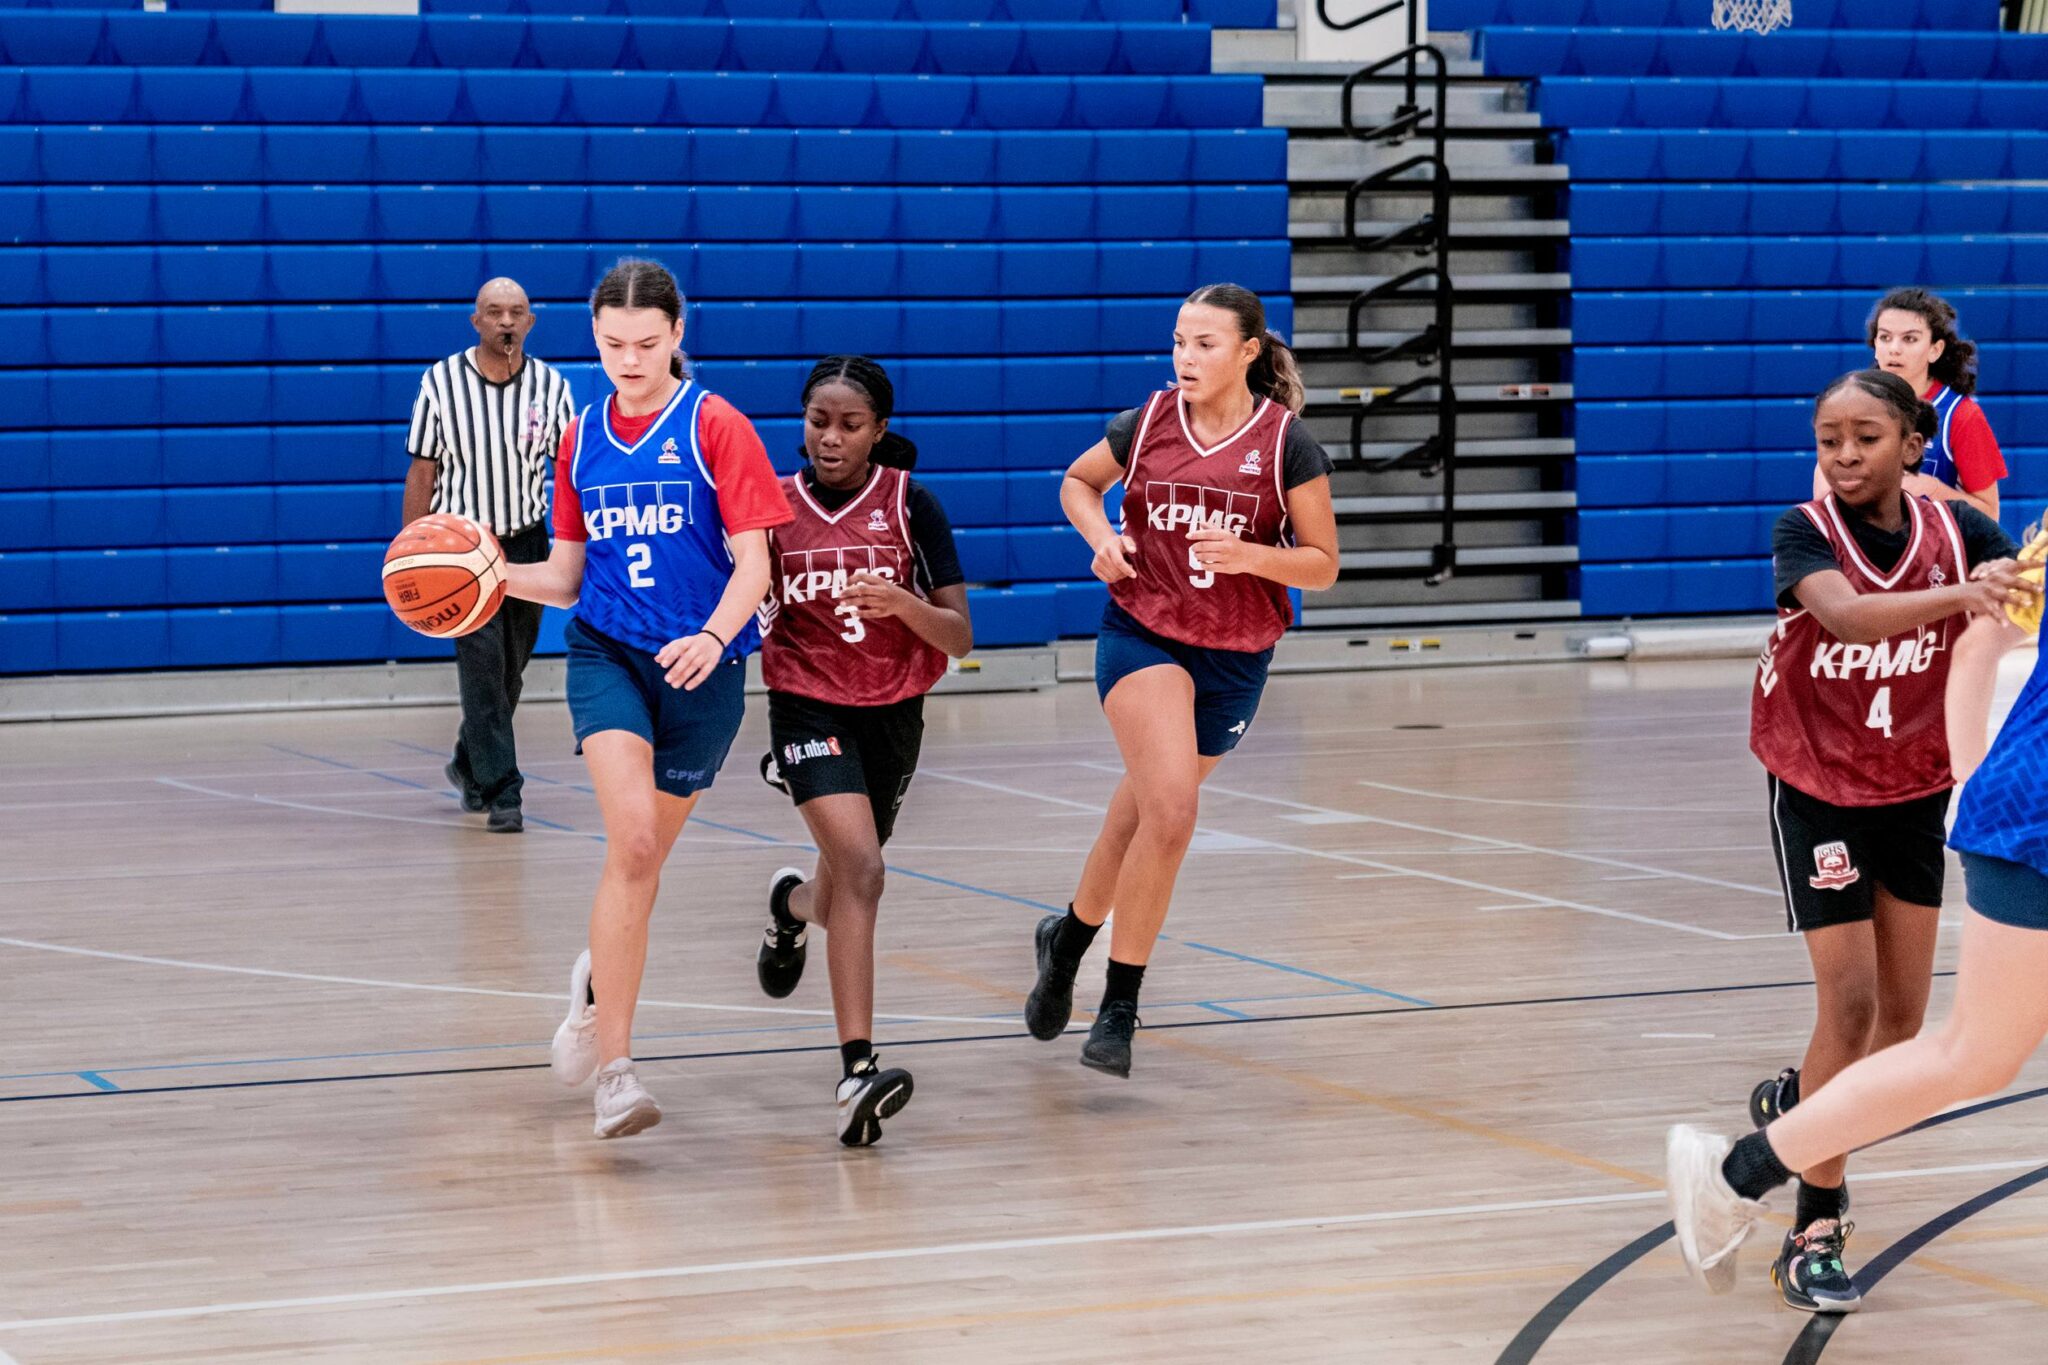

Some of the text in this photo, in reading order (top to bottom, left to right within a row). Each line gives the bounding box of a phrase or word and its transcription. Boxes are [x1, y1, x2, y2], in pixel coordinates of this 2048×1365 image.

[584, 504, 684, 541] KPMG
[1147, 502, 1247, 537] KPMG
[627, 543, 655, 588] 2
[397, 588, 420, 603] FIBA
[405, 603, 461, 632] molt
[834, 603, 866, 643] 3
[1810, 631, 1937, 680] KPMG
[1865, 687, 1892, 738] 4
